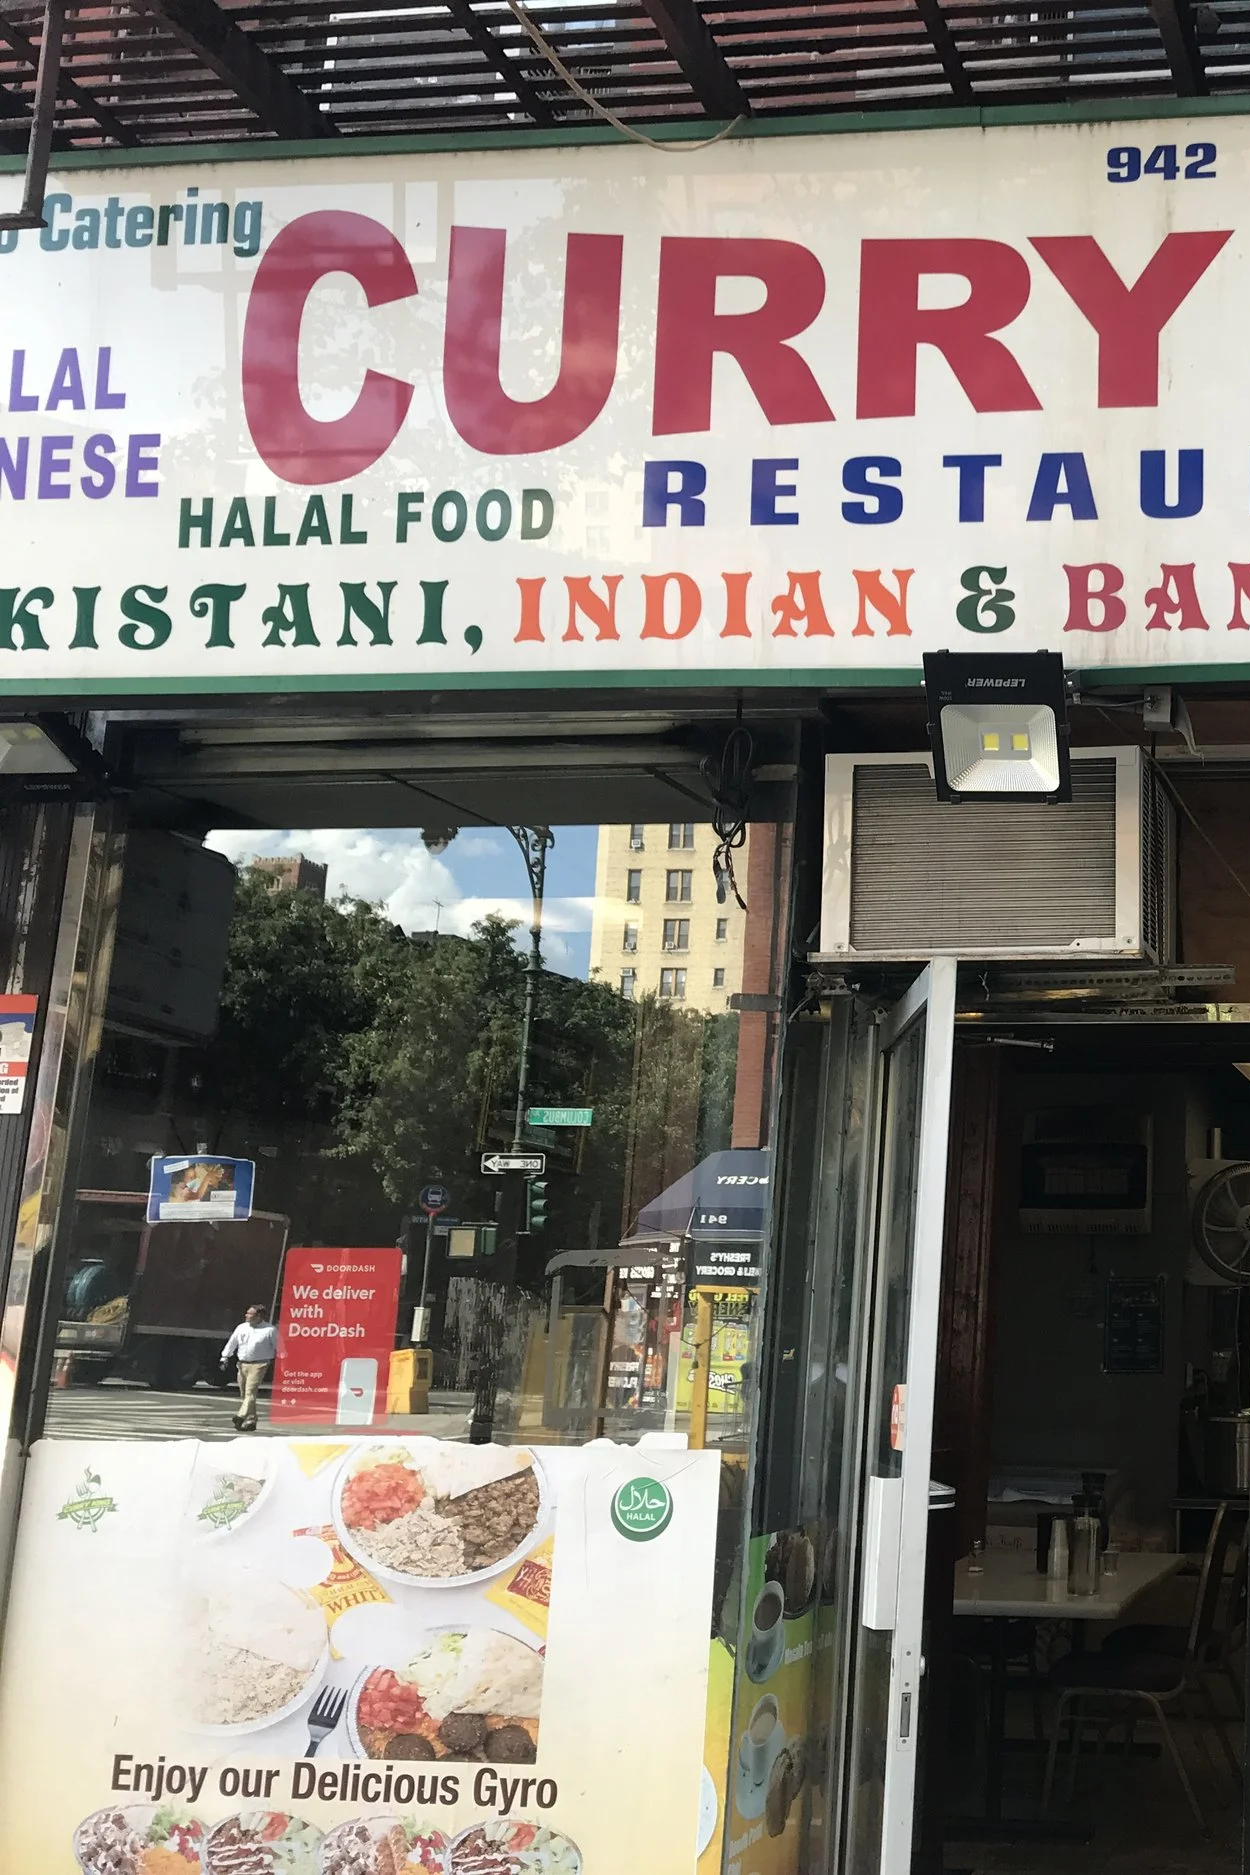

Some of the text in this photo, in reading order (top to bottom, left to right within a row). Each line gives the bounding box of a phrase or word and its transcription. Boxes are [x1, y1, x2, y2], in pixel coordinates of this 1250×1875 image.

[1106, 142, 1217, 183] 942
[40, 186, 263, 258] Catering
[241, 209, 1235, 486] CURRY
[9, 347, 126, 412] LAL
[0, 433, 161, 500] NESE
[179, 488, 555, 548] HALAL FOOD
[0, 579, 484, 656] KISTANI,
[512, 567, 915, 643] INDIAN
[956, 565, 1016, 634] &
[293, 1285, 376, 1300] We deliver
[326, 1264, 376, 1273] DOORDASH
[289, 1323, 365, 1337] DoorDash
[290, 1304, 323, 1318] with
[620, 1485, 666, 1510] حلال
[626, 1513, 656, 1521] HALAL
[110, 1754, 558, 1815] Enjoy our Delicious Gyro
